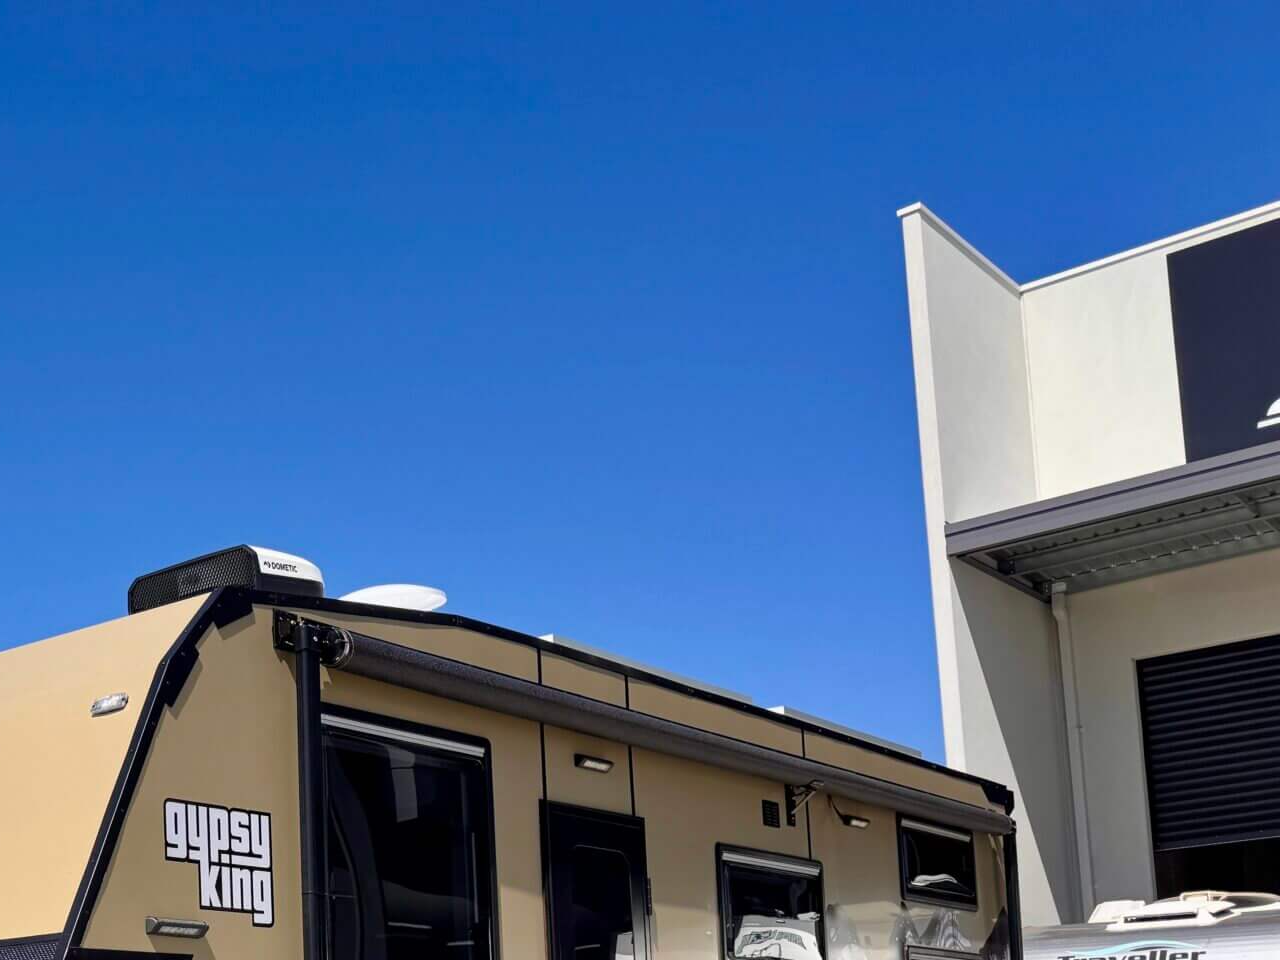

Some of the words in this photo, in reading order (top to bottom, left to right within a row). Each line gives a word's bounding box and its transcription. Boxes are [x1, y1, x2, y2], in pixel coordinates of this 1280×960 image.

[272, 562, 298, 573] DOMETIC
[164, 799, 272, 870] gypsy
[200, 858, 274, 927] king
